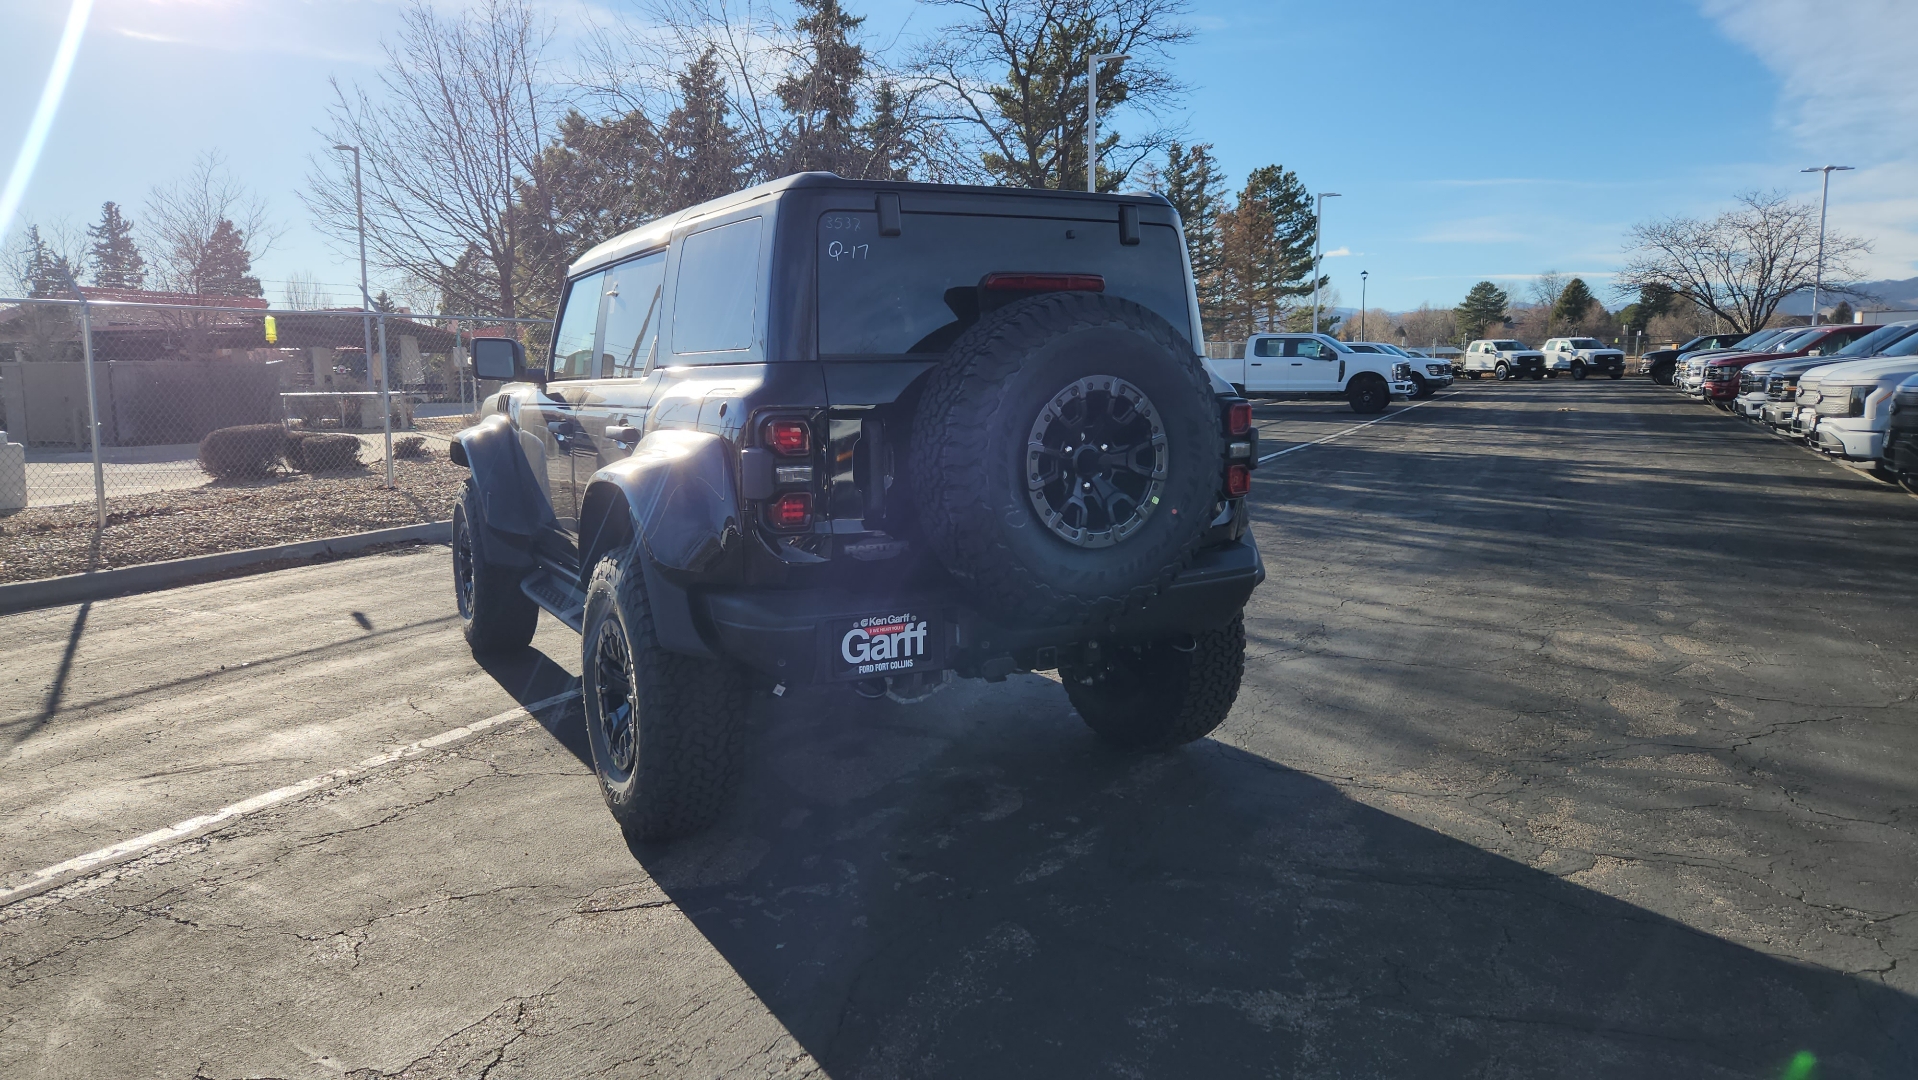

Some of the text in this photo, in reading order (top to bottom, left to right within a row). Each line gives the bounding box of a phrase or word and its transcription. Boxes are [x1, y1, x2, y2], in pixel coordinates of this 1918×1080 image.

[828, 240, 869, 261] Q-17
[869, 613, 910, 627] Ken Garff
[842, 621, 927, 663] Garff
[858, 659, 914, 674] FORD FORT COLLINS
